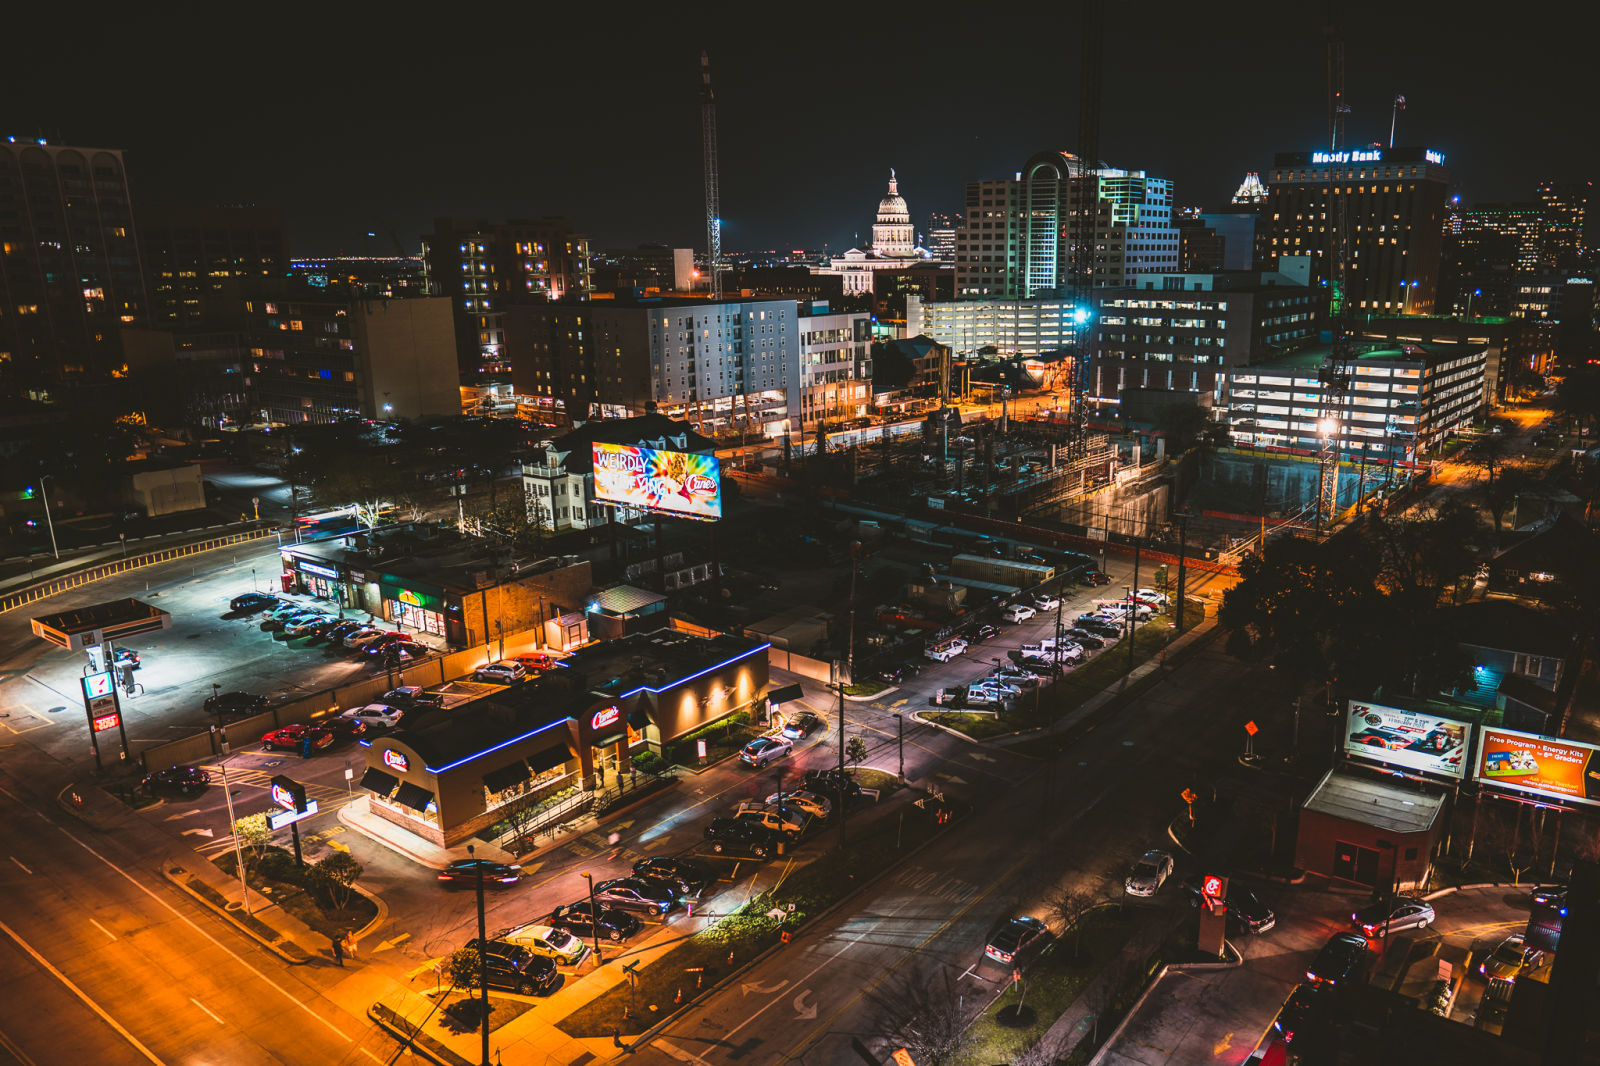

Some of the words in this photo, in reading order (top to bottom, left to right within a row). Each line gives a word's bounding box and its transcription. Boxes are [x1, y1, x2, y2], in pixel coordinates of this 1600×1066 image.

[1352, 150, 1381, 161] Bank
[597, 451, 649, 473] WEIRDLY
[599, 469, 666, 496] SFYING
[1489, 735, 1505, 744] Free
[1506, 739, 1536, 750] Program
[1542, 745, 1568, 755] Energy
[1569, 750, 1584, 758] Kits
[1554, 754, 1583, 764] Graders
